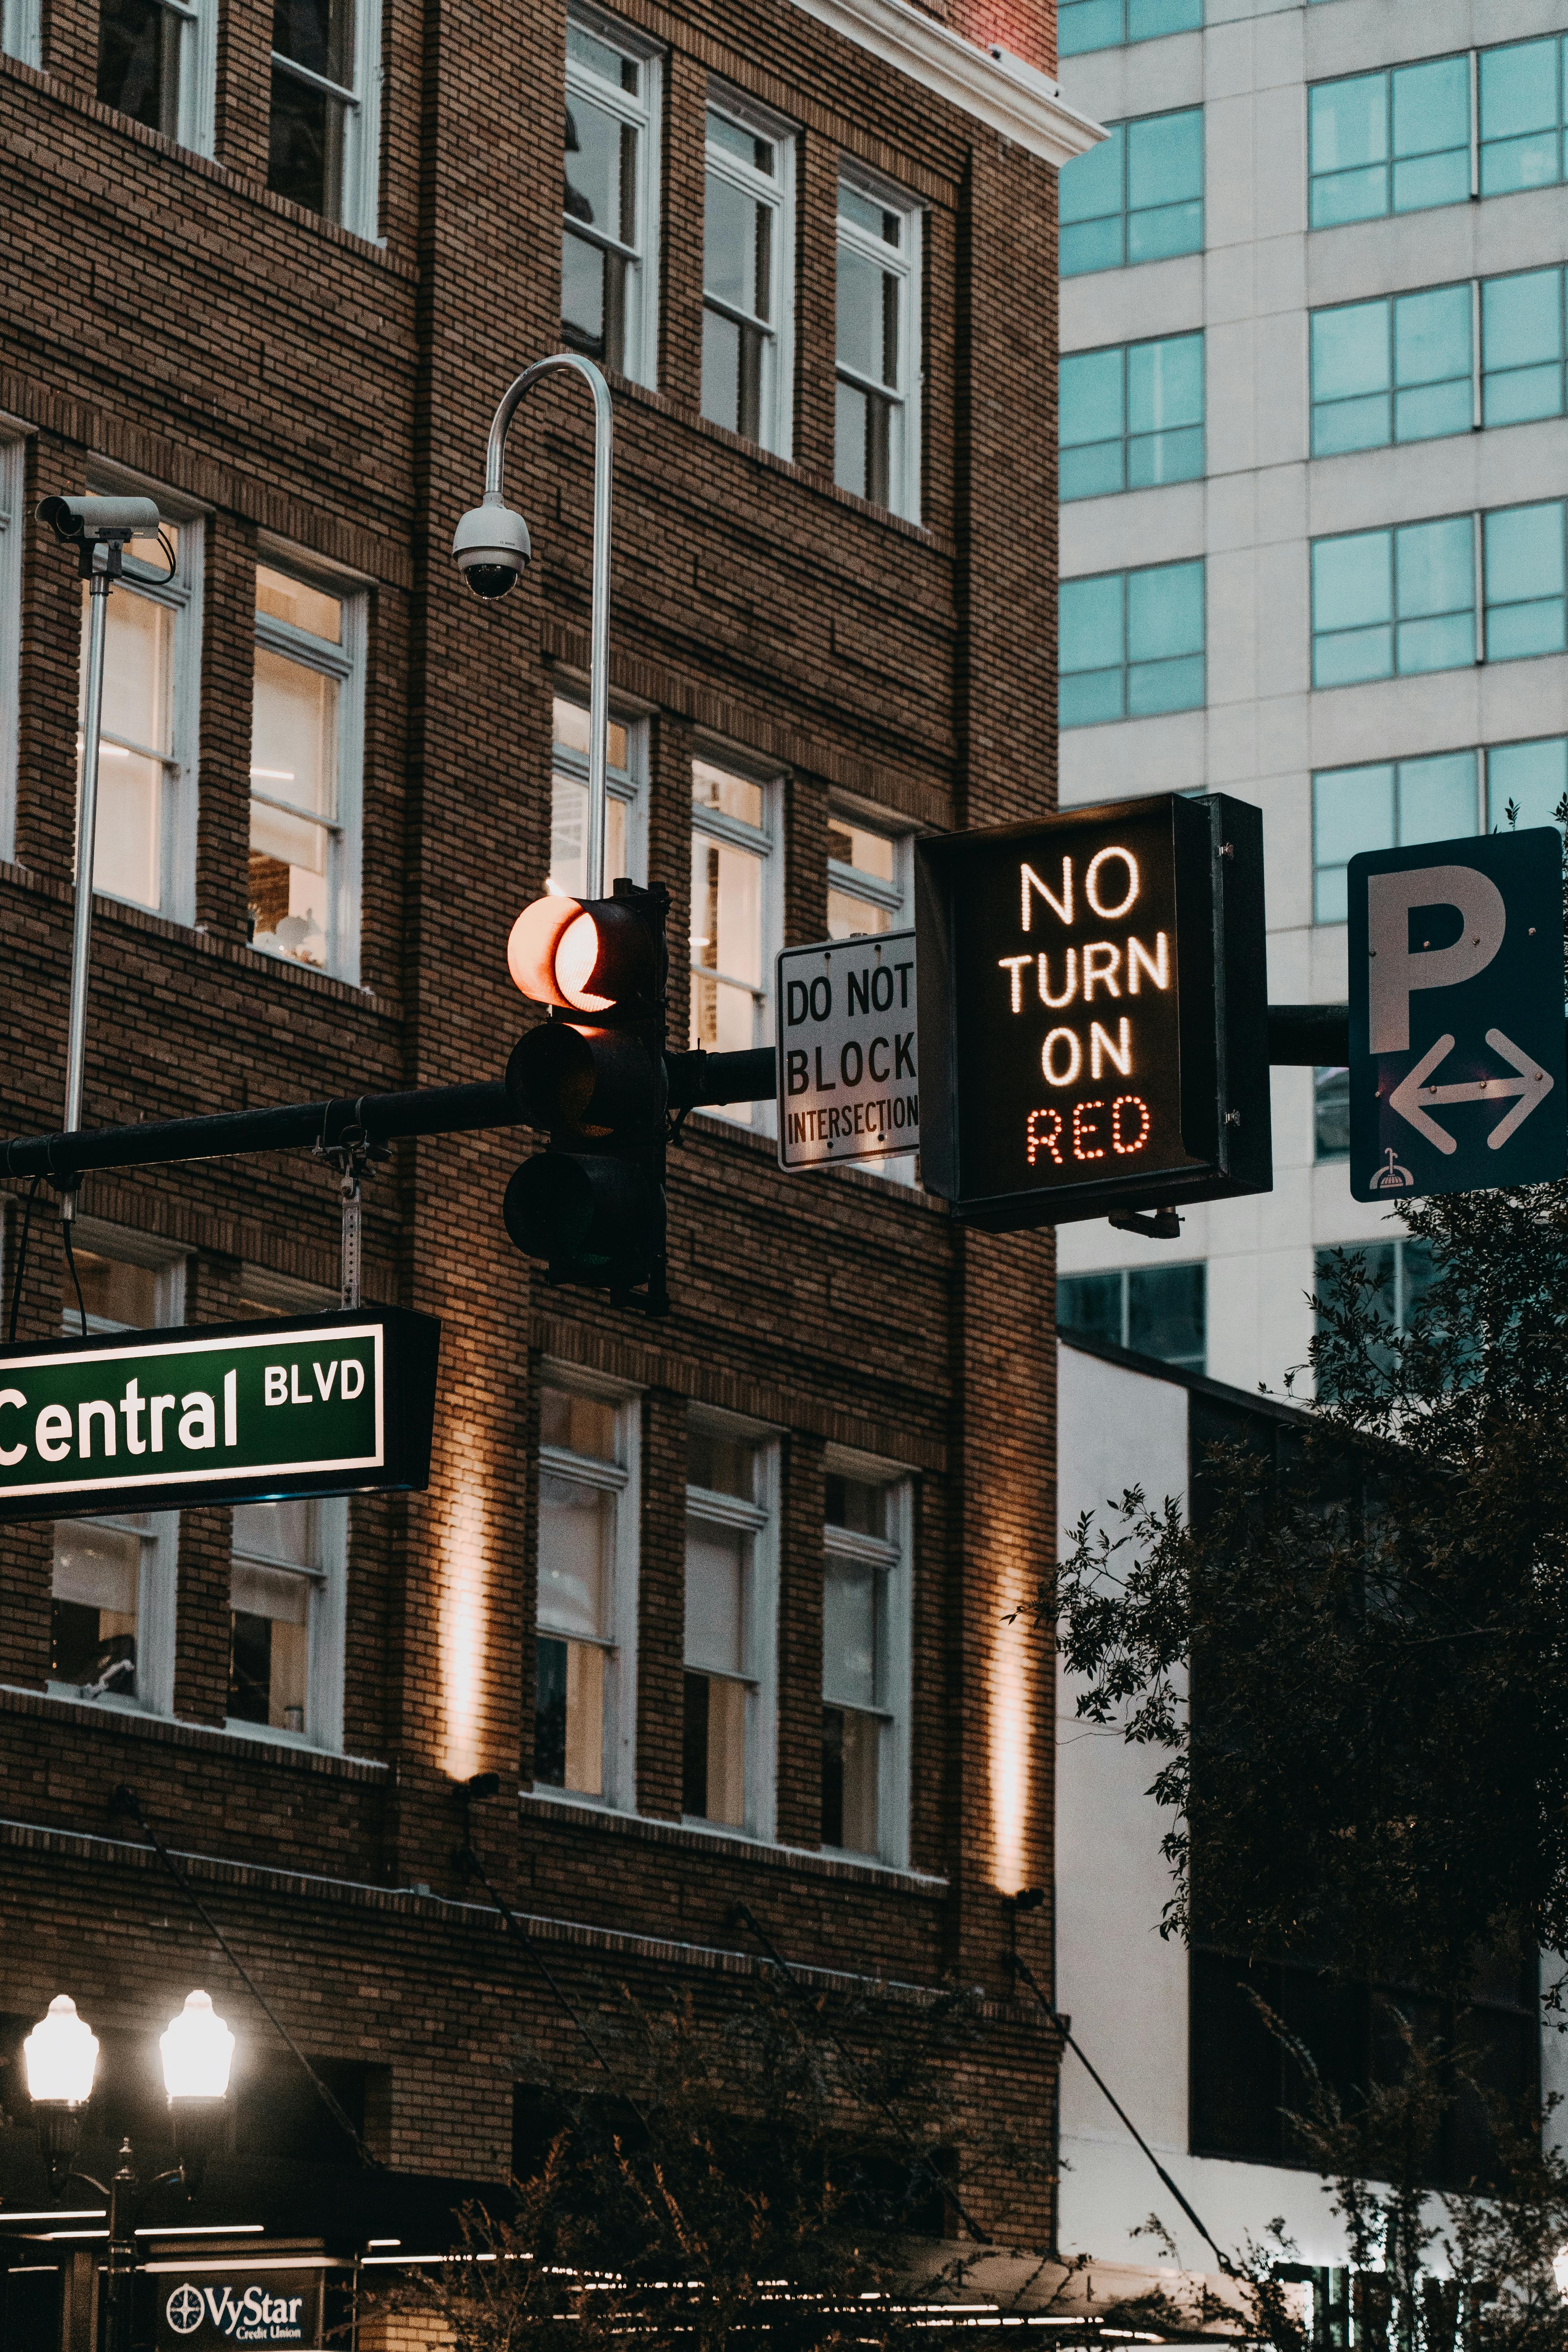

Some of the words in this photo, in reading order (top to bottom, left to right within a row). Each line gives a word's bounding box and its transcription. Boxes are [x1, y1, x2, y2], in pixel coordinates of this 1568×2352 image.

[1020, 846, 1139, 931] NO
[787, 976, 831, 1026] DO
[848, 962, 914, 1016] NOT
[998, 932, 1168, 1013] TURN
[1368, 865, 1506, 1054] P
[787, 1032, 916, 1096] BLOCK
[1042, 1017, 1131, 1086] ON
[788, 1095, 918, 1144] INTERSECTION
[1027, 1095, 1149, 1165] RED
[0, 1369, 236, 1466] Central
[265, 1359, 365, 1406] BLVD
[203, 2286, 302, 2335] VyStar
[236, 2325, 267, 2339] Credit
[270, 2325, 301, 2338] Union
